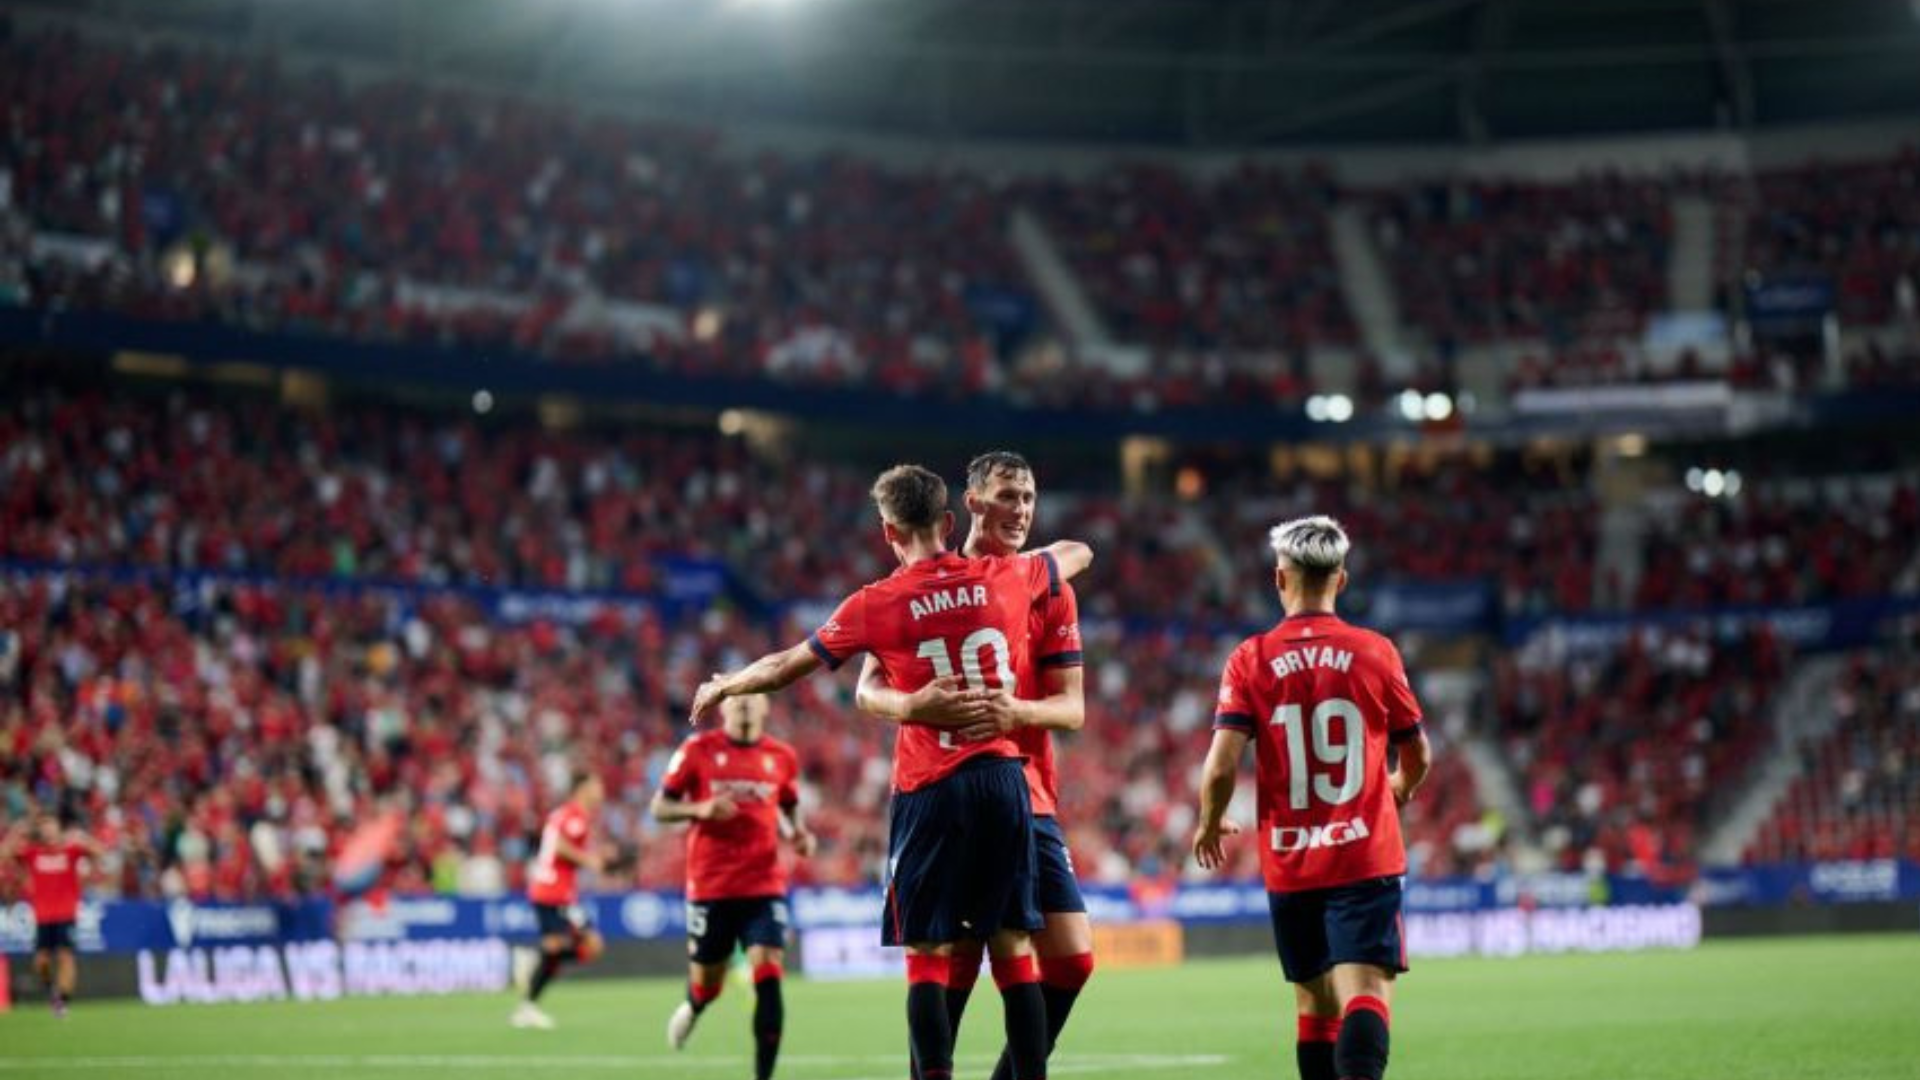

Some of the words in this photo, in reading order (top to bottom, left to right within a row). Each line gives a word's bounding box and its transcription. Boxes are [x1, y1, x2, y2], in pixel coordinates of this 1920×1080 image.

[909, 585, 988, 620] AIMAR
[916, 627, 1016, 748] 10
[1270, 646, 1353, 679] BRYAN
[1270, 698, 1364, 810] 19
[1271, 817, 1370, 851] DIGI
[138, 948, 286, 1004] LALIGA
[284, 938, 342, 999] VS
